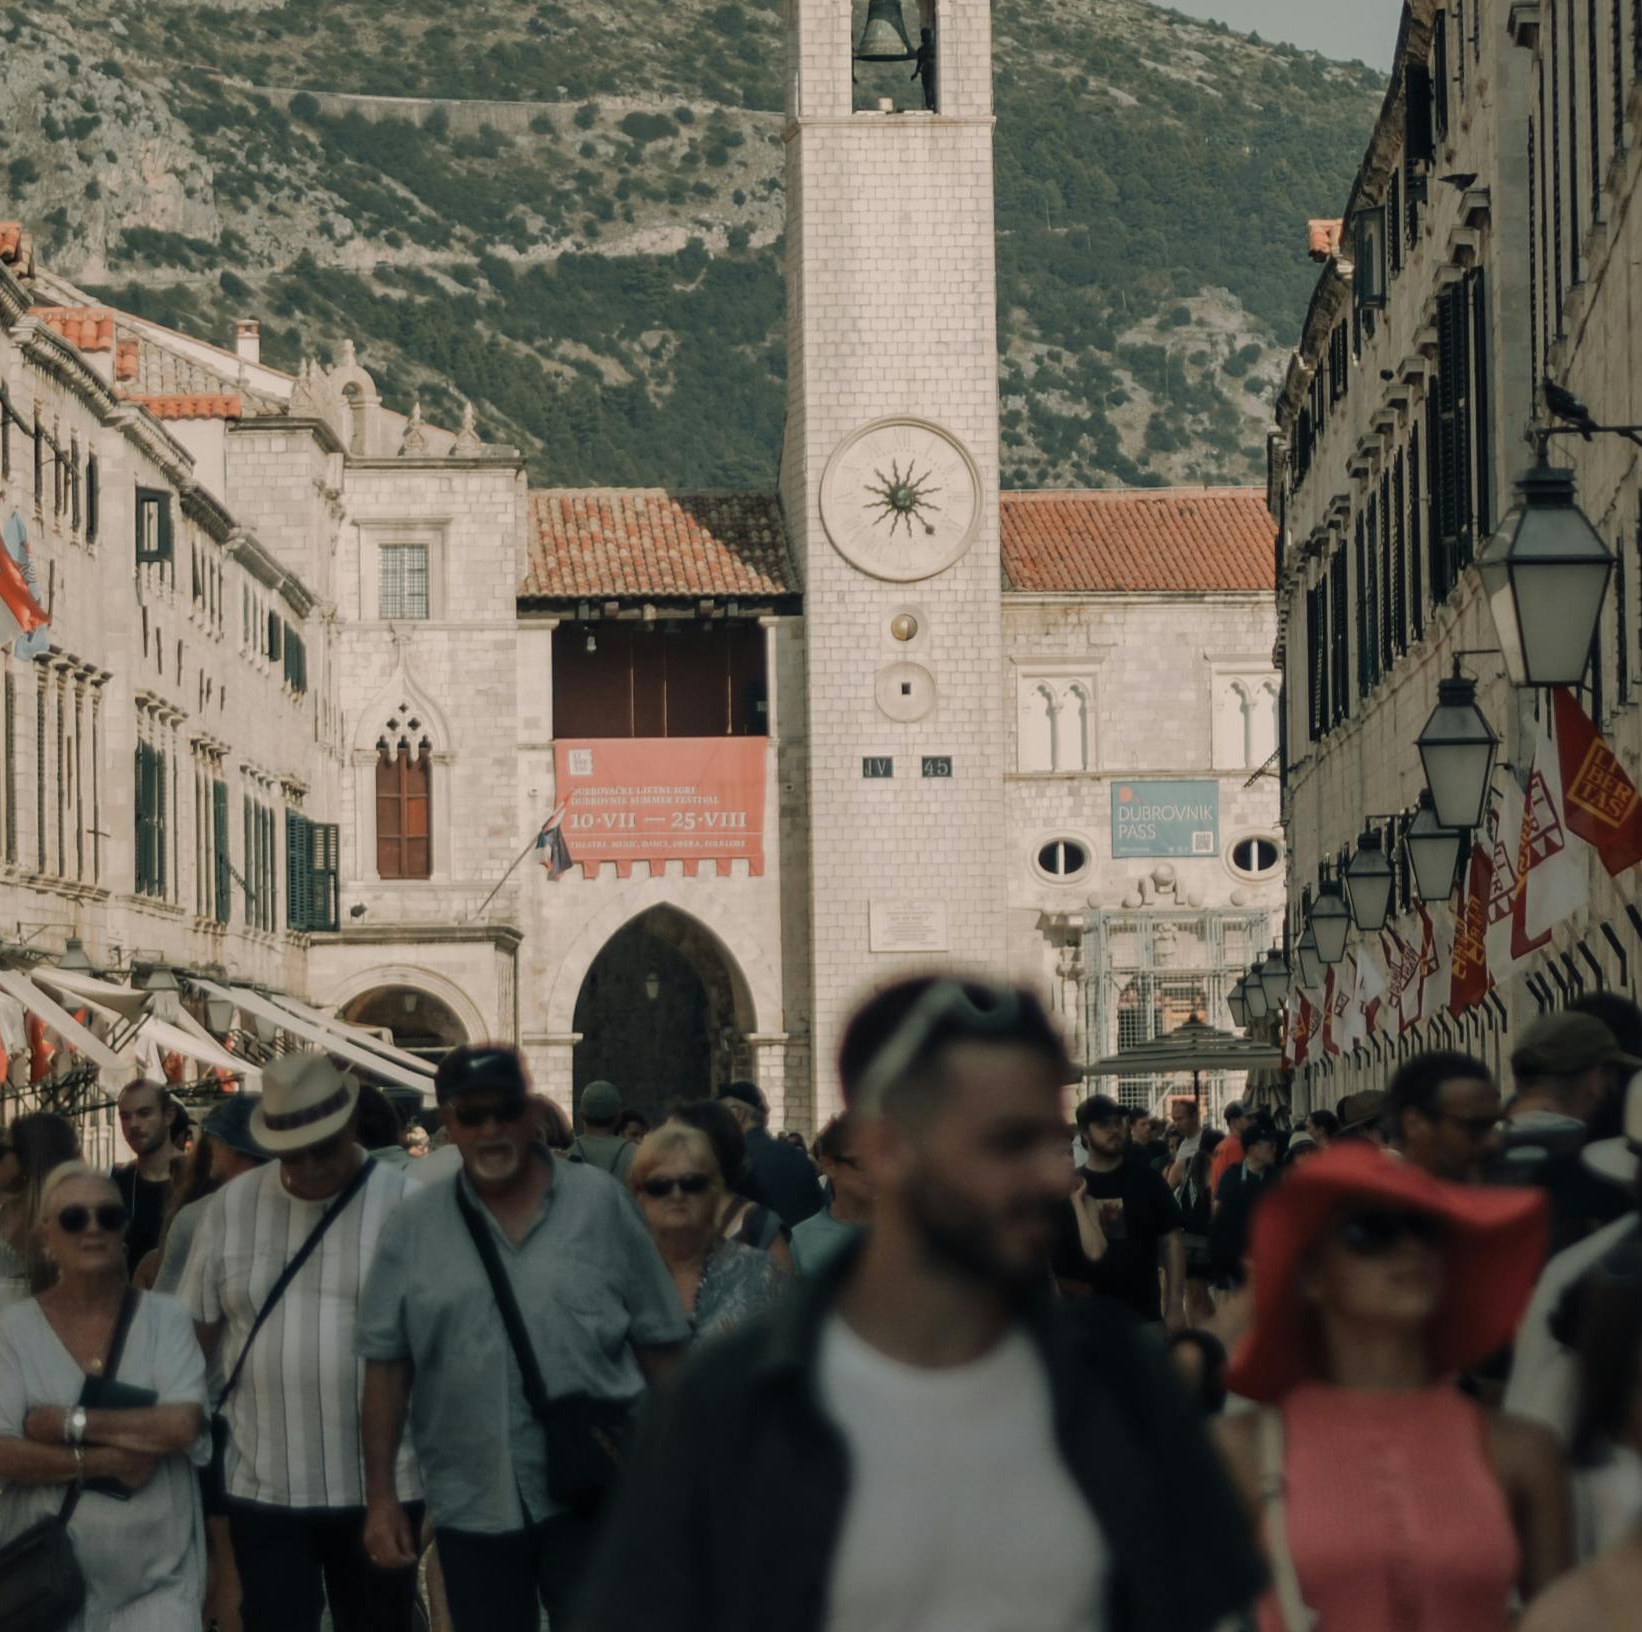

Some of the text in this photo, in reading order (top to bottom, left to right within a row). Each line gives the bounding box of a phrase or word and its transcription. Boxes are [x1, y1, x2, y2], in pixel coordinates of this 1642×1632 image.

[924, 759, 949, 776] 45
[1586, 765, 1633, 802] BER
[571, 795, 720, 806] DUBROVNIK SUMMER FESTIVAL
[1580, 778, 1626, 818] TAS
[1119, 805, 1214, 822] DUBROVNIK
[1118, 823, 1157, 840] PASS
